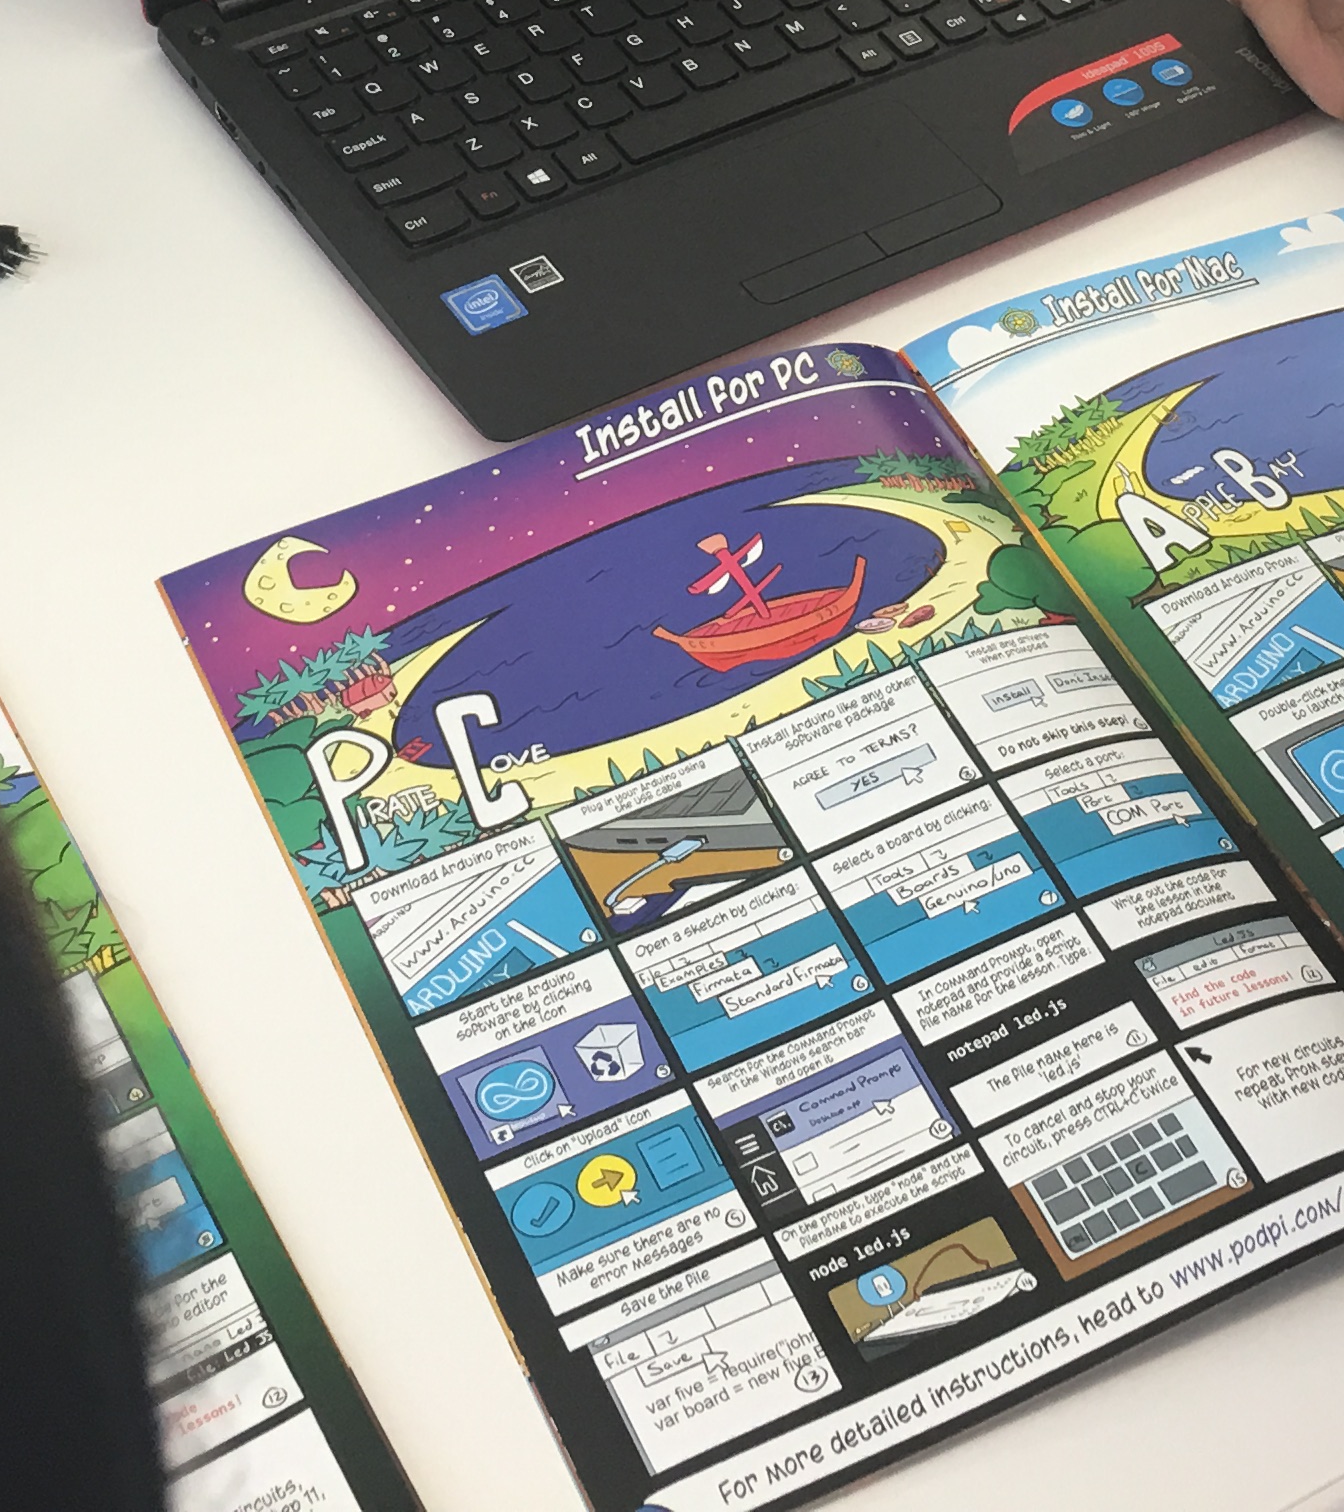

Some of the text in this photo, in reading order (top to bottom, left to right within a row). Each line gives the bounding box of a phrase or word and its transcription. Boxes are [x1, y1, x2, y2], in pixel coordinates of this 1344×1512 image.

[946, 14, 967, 29] Ctrl
[268, 41, 290, 54] Esc
[860, 48, 878, 60] Alt
[1081, 41, 1166, 80] ideapad 100S
[313, 105, 336, 120] Tab
[342, 133, 387, 157] CapsLk
[582, 152, 597, 165] Alt
[372, 176, 403, 194] Shift
[404, 215, 427, 232] Ctrl
[465, 293, 498, 313] intel
[1042, 249, 1244, 327] Install for Mac
[576, 343, 818, 464] Install for PC
[1258, 685, 1328, 721] Double-click
[1291, 708, 1307, 720] to
[1306, 692, 1344, 714] launch
[997, 714, 1134, 757] Do not skip this step!
[792, 722, 918, 789] AGREE TO TERMS?
[1045, 749, 1124, 779] Select a port:
[850, 771, 879, 792] YES
[1106, 798, 1184, 827] COM Port
[369, 835, 535, 904] Download Arduino from:
[871, 866, 914, 886] Tools
[896, 864, 960, 901] Boards
[407, 927, 508, 1017] ARDUINO
[692, 967, 752, 997] Firmata
[456, 978, 592, 1041] software by clicking
[459, 970, 575, 1025] Start the Arduino
[494, 1004, 567, 1040] on the icon
[947, 999, 1066, 1061] notepad led.js
[986, 1022, 1118, 1092] The file name here is
[1236, 1063, 1260, 1081] For
[1261, 1051, 1292, 1071] new
[1234, 1072, 1285, 1101] repeat
[1284, 1060, 1327, 1083] from
[1256, 1088, 1291, 1109] with
[1290, 1077, 1320, 1096] new
[1002, 1075, 1178, 1167] circuit, press CTRL+C twice
[1003, 1067, 1156, 1147] To cancel and stop your
[556, 1206, 720, 1287] Make sure there are no
[809, 1227, 910, 1281] node led.js
[590, 1263, 628, 1289] error
[620, 1269, 710, 1317] Save the file
[183, 1289, 229, 1321] editor
[646, 1350, 693, 1377] Save
[718, 1473, 758, 1505] For
[765, 1443, 824, 1485] more
[830, 1393, 927, 1454] detailed
[929, 1330, 1075, 1413] instructions,
[1077, 1291, 1137, 1335] head
[1136, 1281, 1164, 1304] to
[179, 1393, 242, 1436] lessons!
